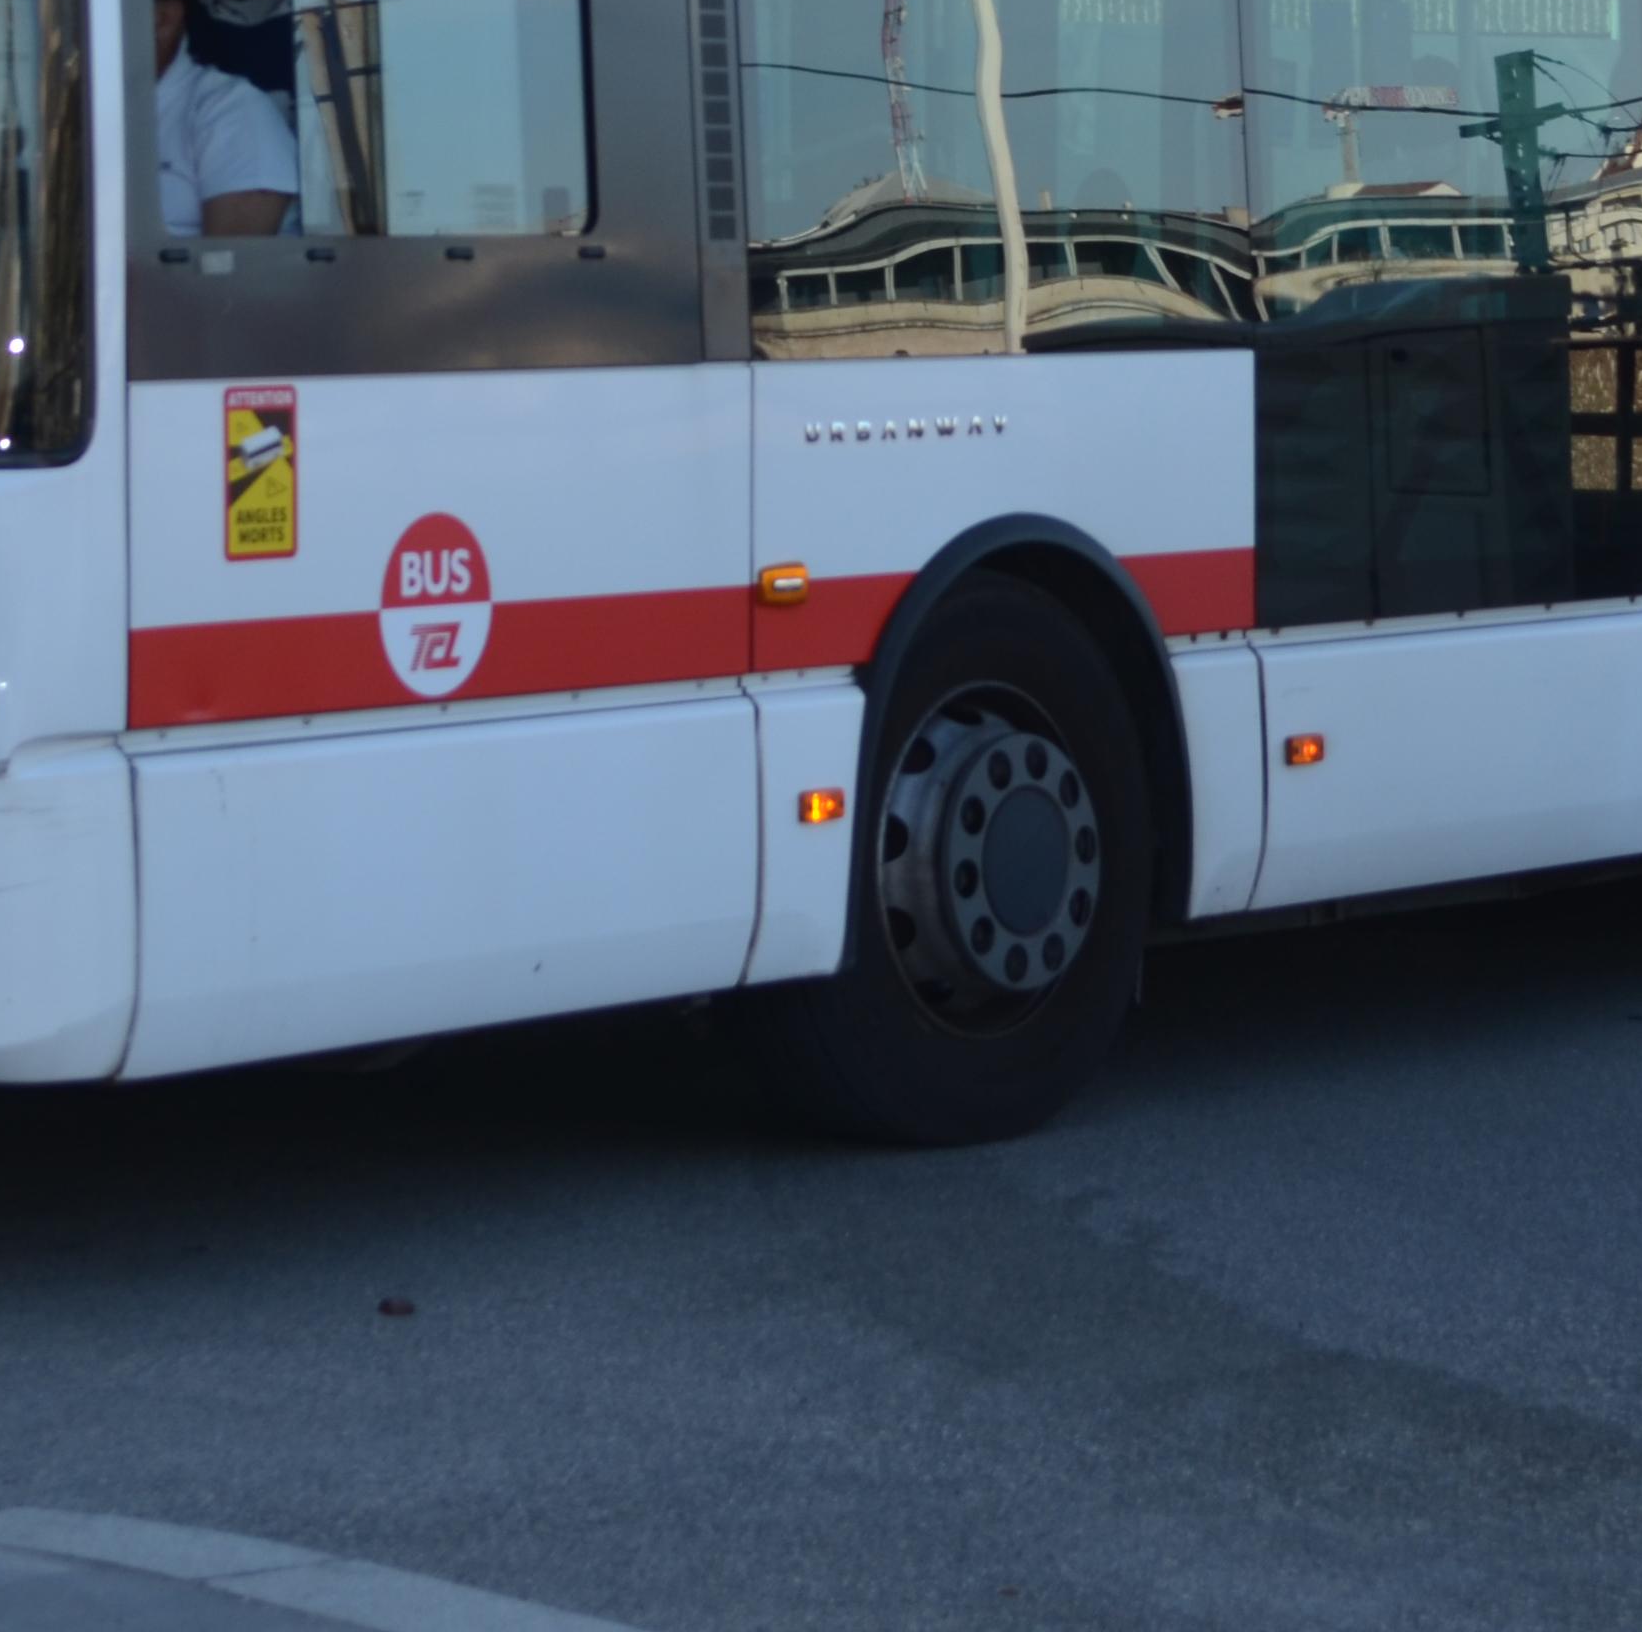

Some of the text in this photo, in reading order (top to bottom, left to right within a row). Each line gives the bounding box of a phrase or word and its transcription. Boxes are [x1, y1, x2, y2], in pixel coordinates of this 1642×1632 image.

[805, 415, 1009, 443] URBANWAY
[236, 505, 288, 526] ANGLES
[237, 525, 286, 545] MORTS
[400, 548, 473, 599] BUS
